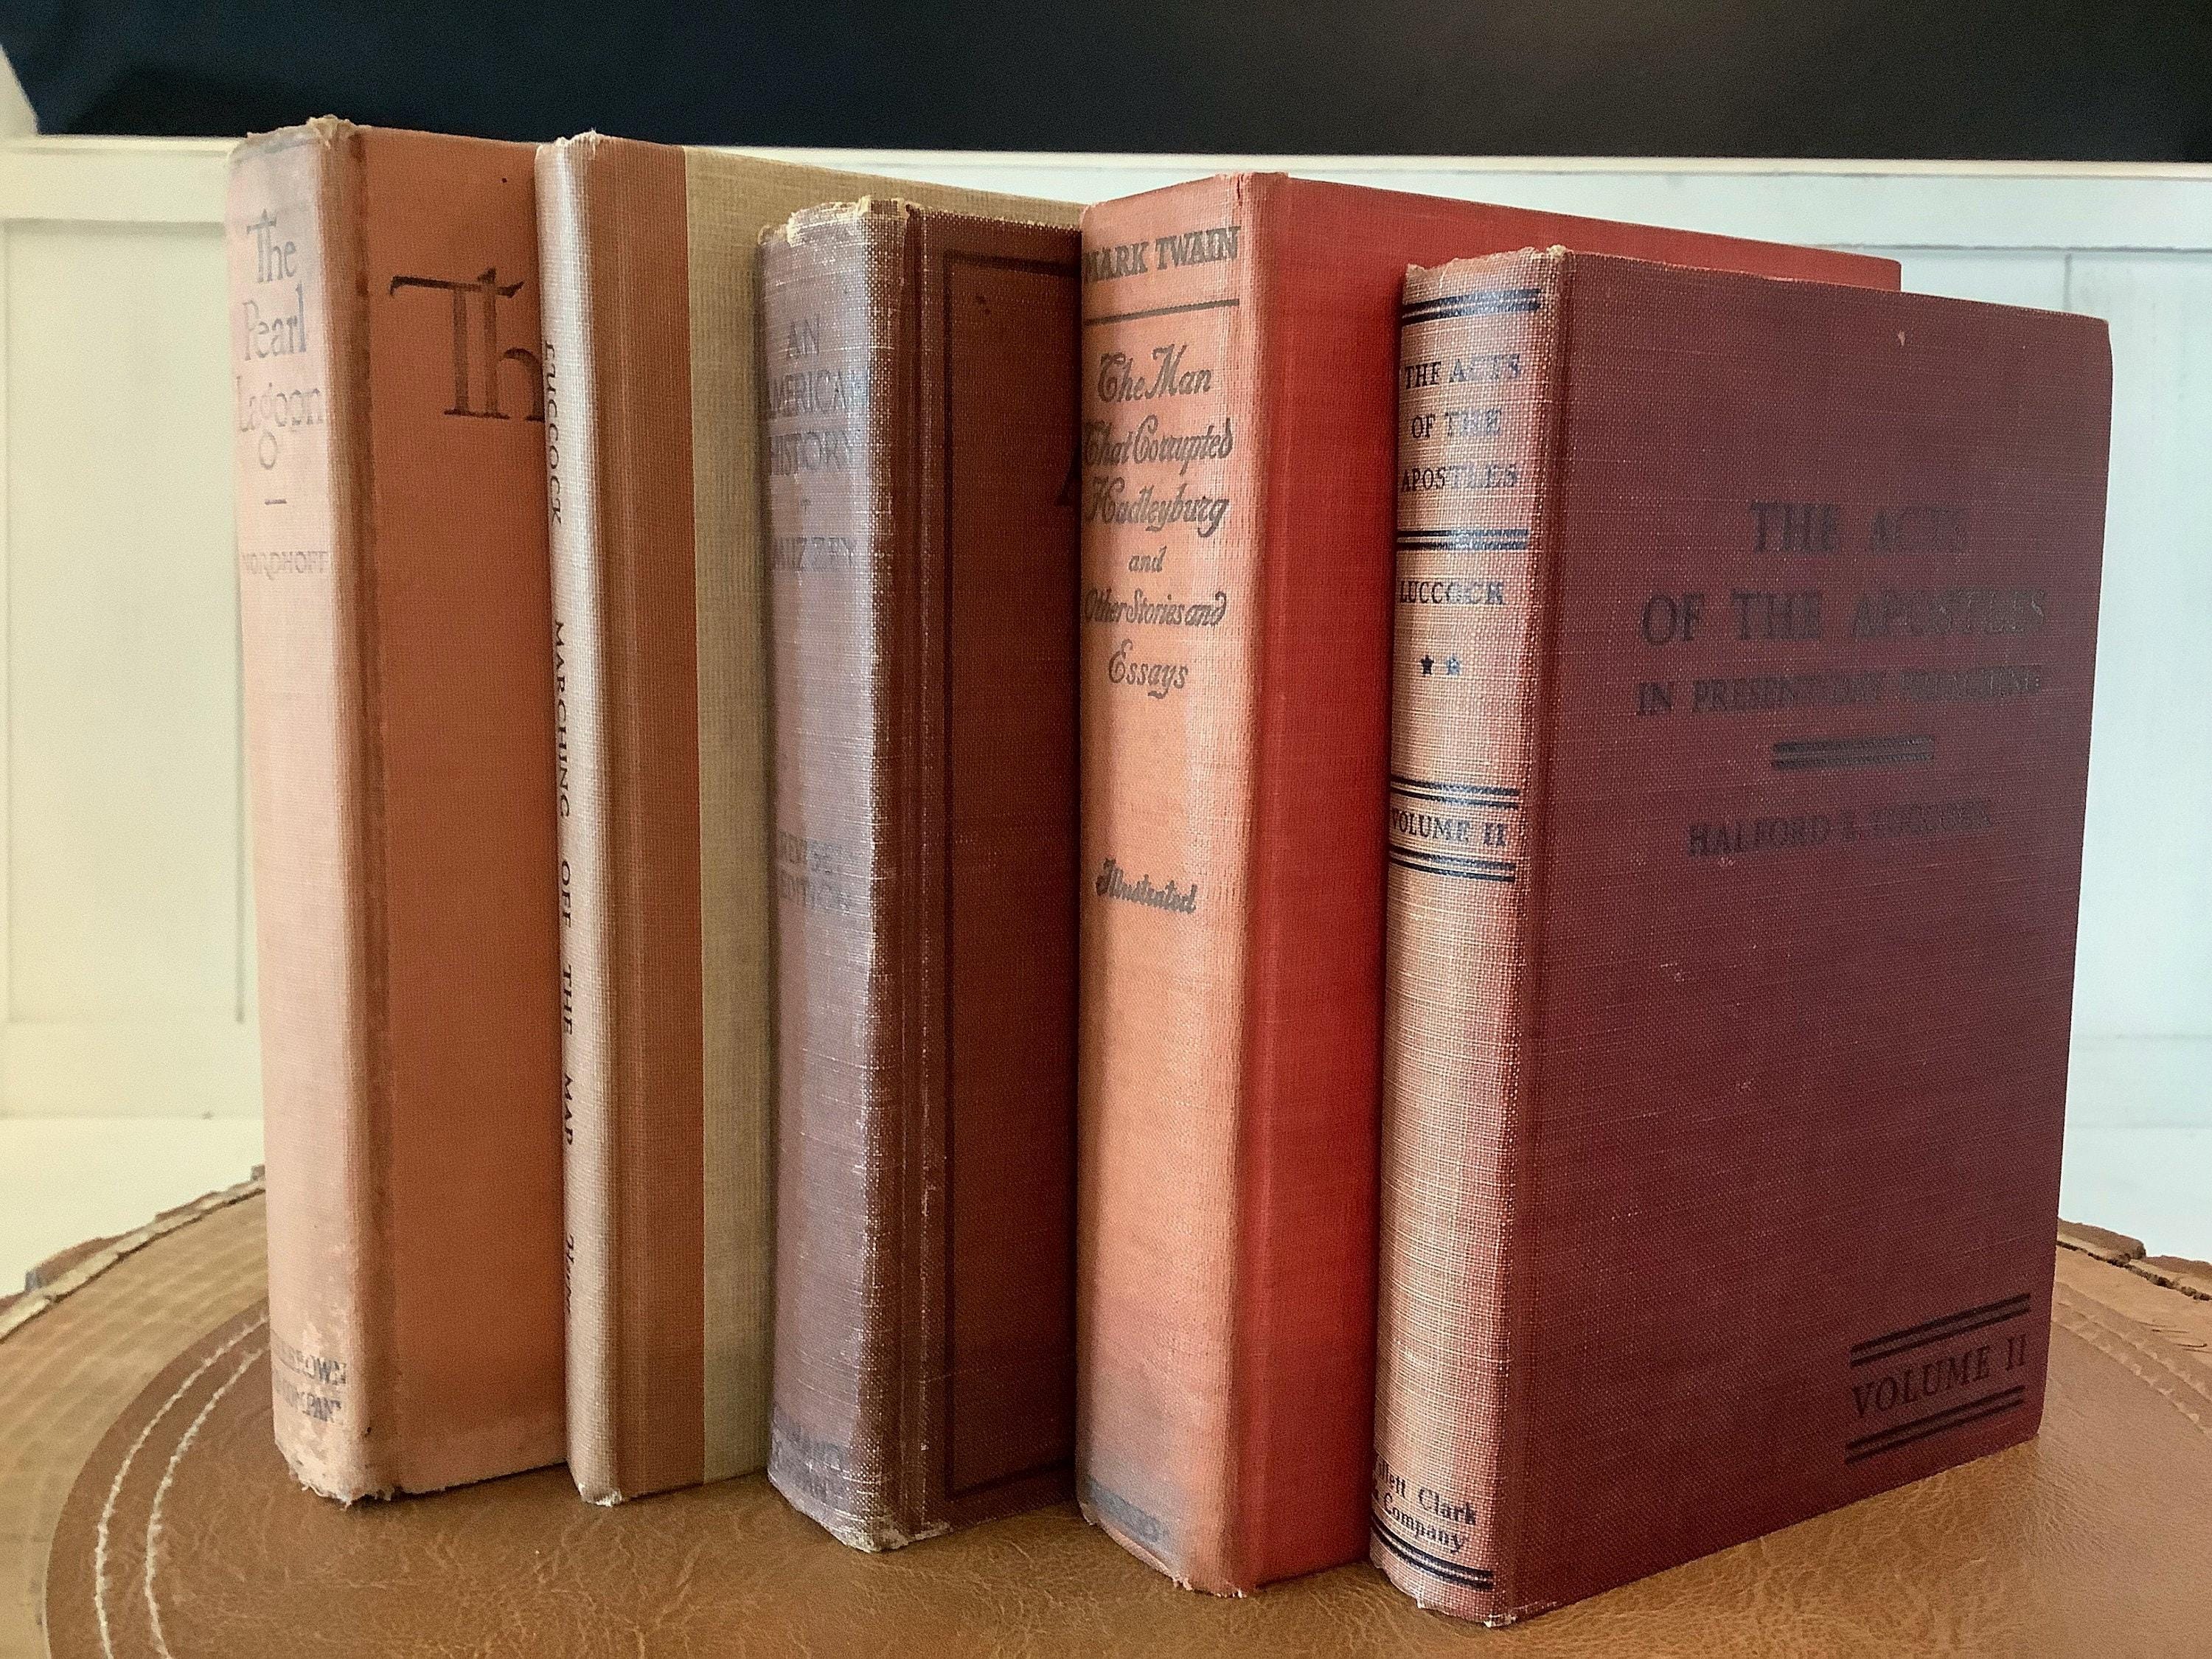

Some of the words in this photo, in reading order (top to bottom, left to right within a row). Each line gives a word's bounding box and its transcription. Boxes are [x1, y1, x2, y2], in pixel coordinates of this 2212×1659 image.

[246, 209, 296, 283] The
[1082, 241, 1150, 283] MARK
[1155, 226, 1242, 271] TWAIN
[241, 279, 307, 361] Pearl
[787, 316, 820, 357] AN
[1097, 352, 1144, 403] The
[1145, 344, 1212, 399] Man
[1405, 361, 1441, 389] THE
[1449, 354, 1520, 383] ACTS
[544, 340, 563, 525] LUCCOCK
[1082, 419, 1133, 466] That
[1133, 414, 1234, 476] Corrupted
[1411, 414, 1436, 439] OF
[1445, 408, 1502, 437] THE
[1401, 463, 1518, 493] APOSTLES
[1083, 476, 1230, 538] Hadleyburg
[1750, 501, 1840, 553] THE
[1128, 546, 1167, 573] and
[1083, 588, 1127, 623] Other
[1126, 588, 1185, 625] Stories
[1184, 591, 1227, 627] and
[1399, 580, 1505, 605] LUCCOCK
[1640, 591, 1705, 645] OF
[1730, 588, 1823, 640] THE
[1108, 638, 1189, 700] Essays
[554, 619, 571, 818] MARCHING
[1635, 682, 1673, 715] IN
[1391, 808, 1470, 843] VOLUME
[1483, 821, 1508, 846] II
[560, 860, 572, 928] OFF
[1095, 857, 1197, 914] Illustrated
[562, 964, 573, 1035] THE
[563, 1074, 574, 1145] MAP
[1852, 1344, 1992, 1419] VOLUME
[2005, 1334, 2026, 1371] II
[1384, 1492, 1467, 1554] Company
[1419, 1486, 1476, 1526] Clark
